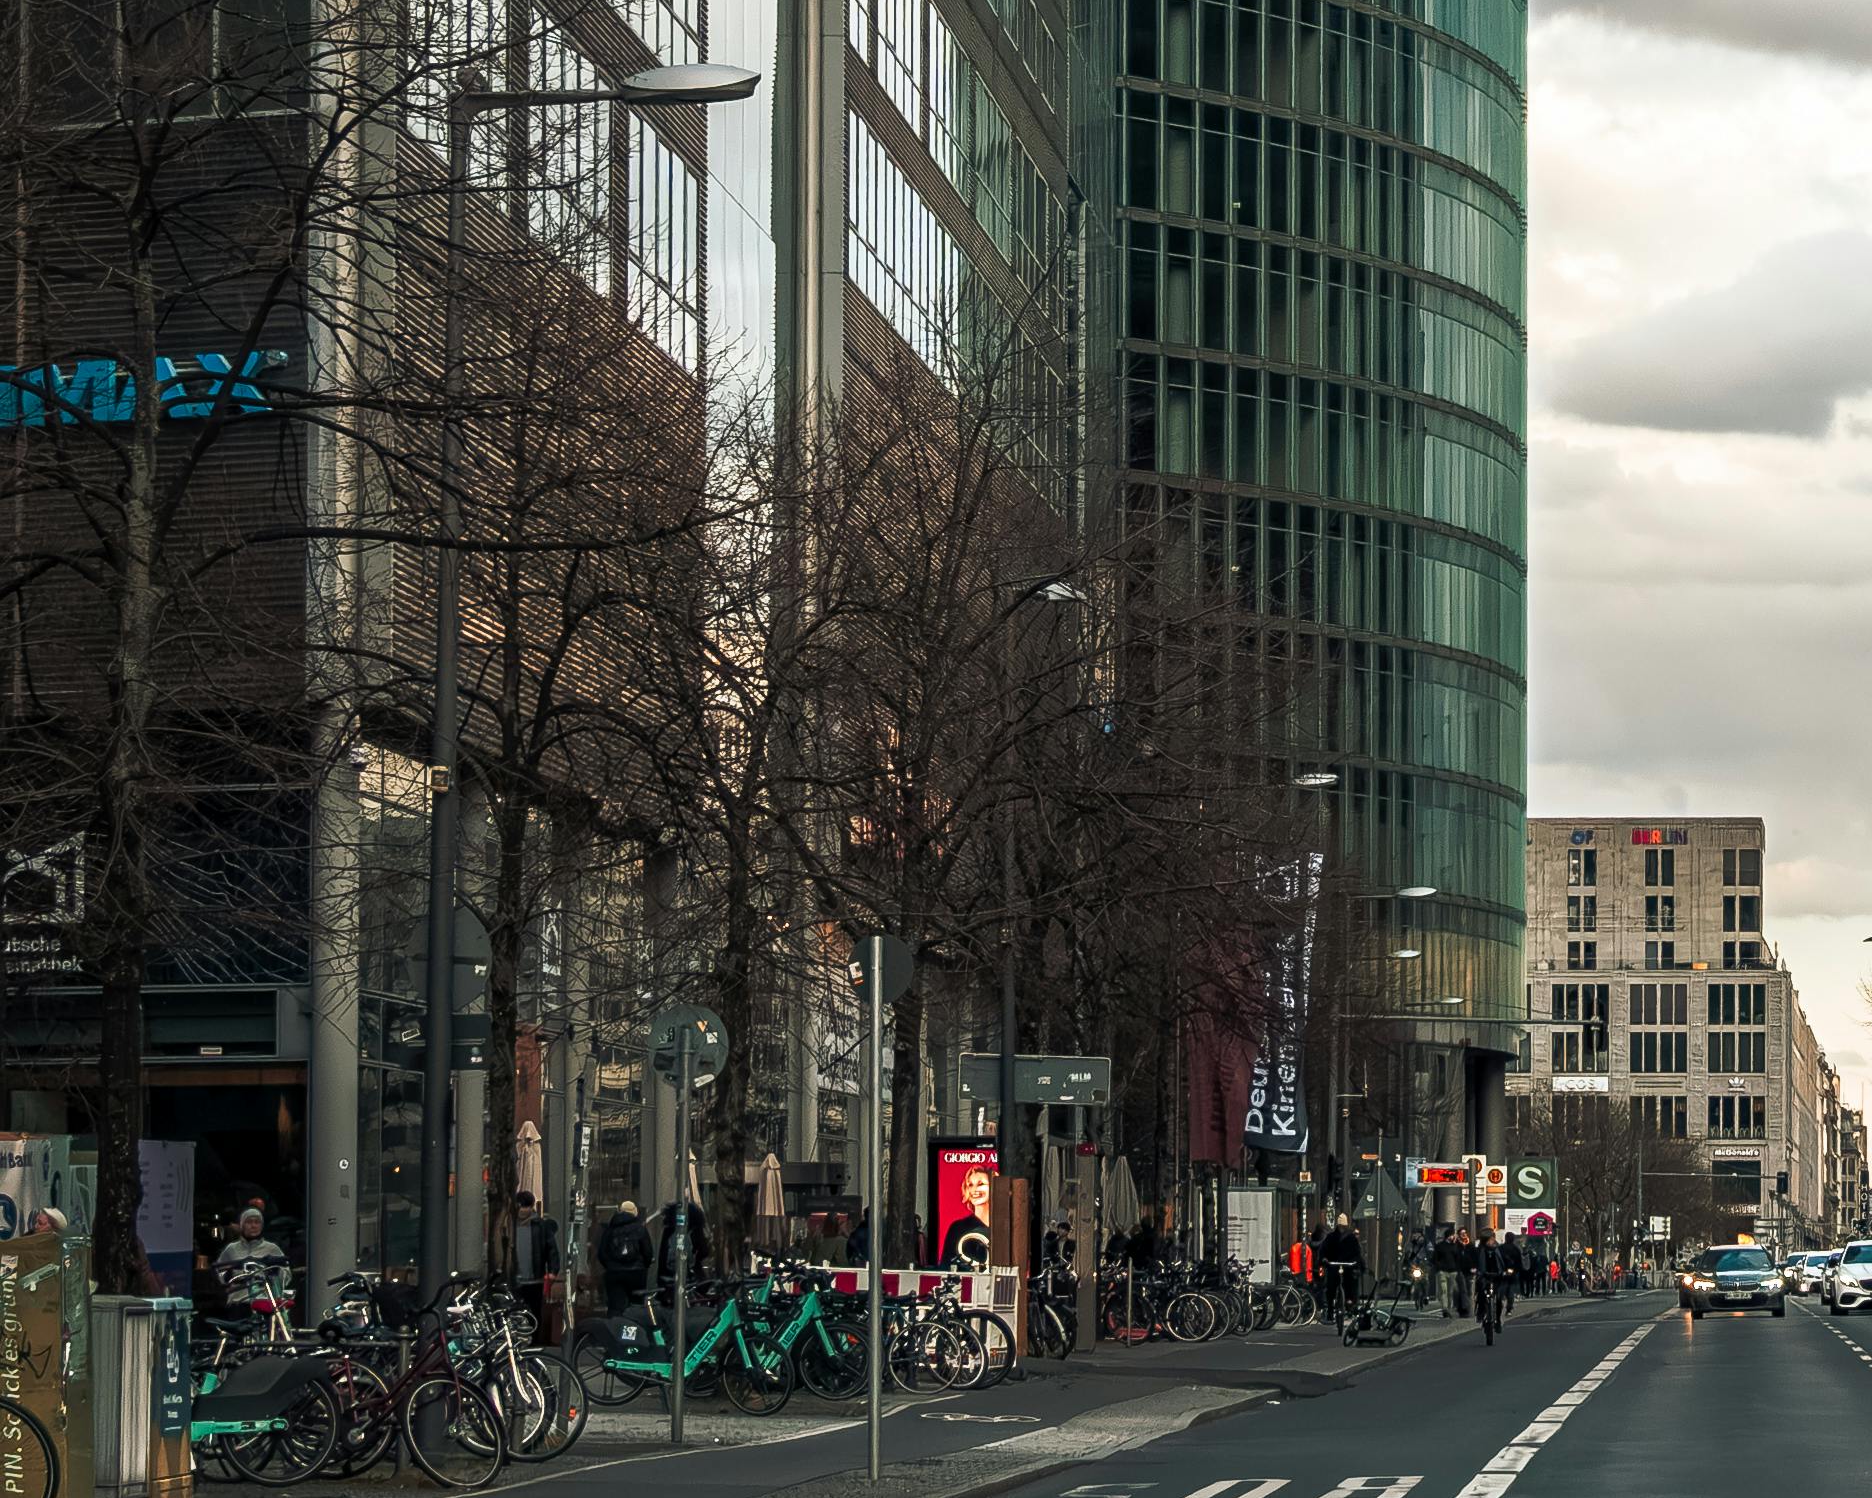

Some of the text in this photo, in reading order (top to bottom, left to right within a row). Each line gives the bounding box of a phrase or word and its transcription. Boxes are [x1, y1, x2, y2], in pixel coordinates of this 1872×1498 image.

[944, 1152, 986, 1164] GIORGIO
[1517, 1166, 1544, 1200] S
[687, 1330, 717, 1363] TIER
[781, 1322, 801, 1347] IER
[1, 1338, 22, 1441] Scickes
[4, 1447, 25, 1493] PIN.
